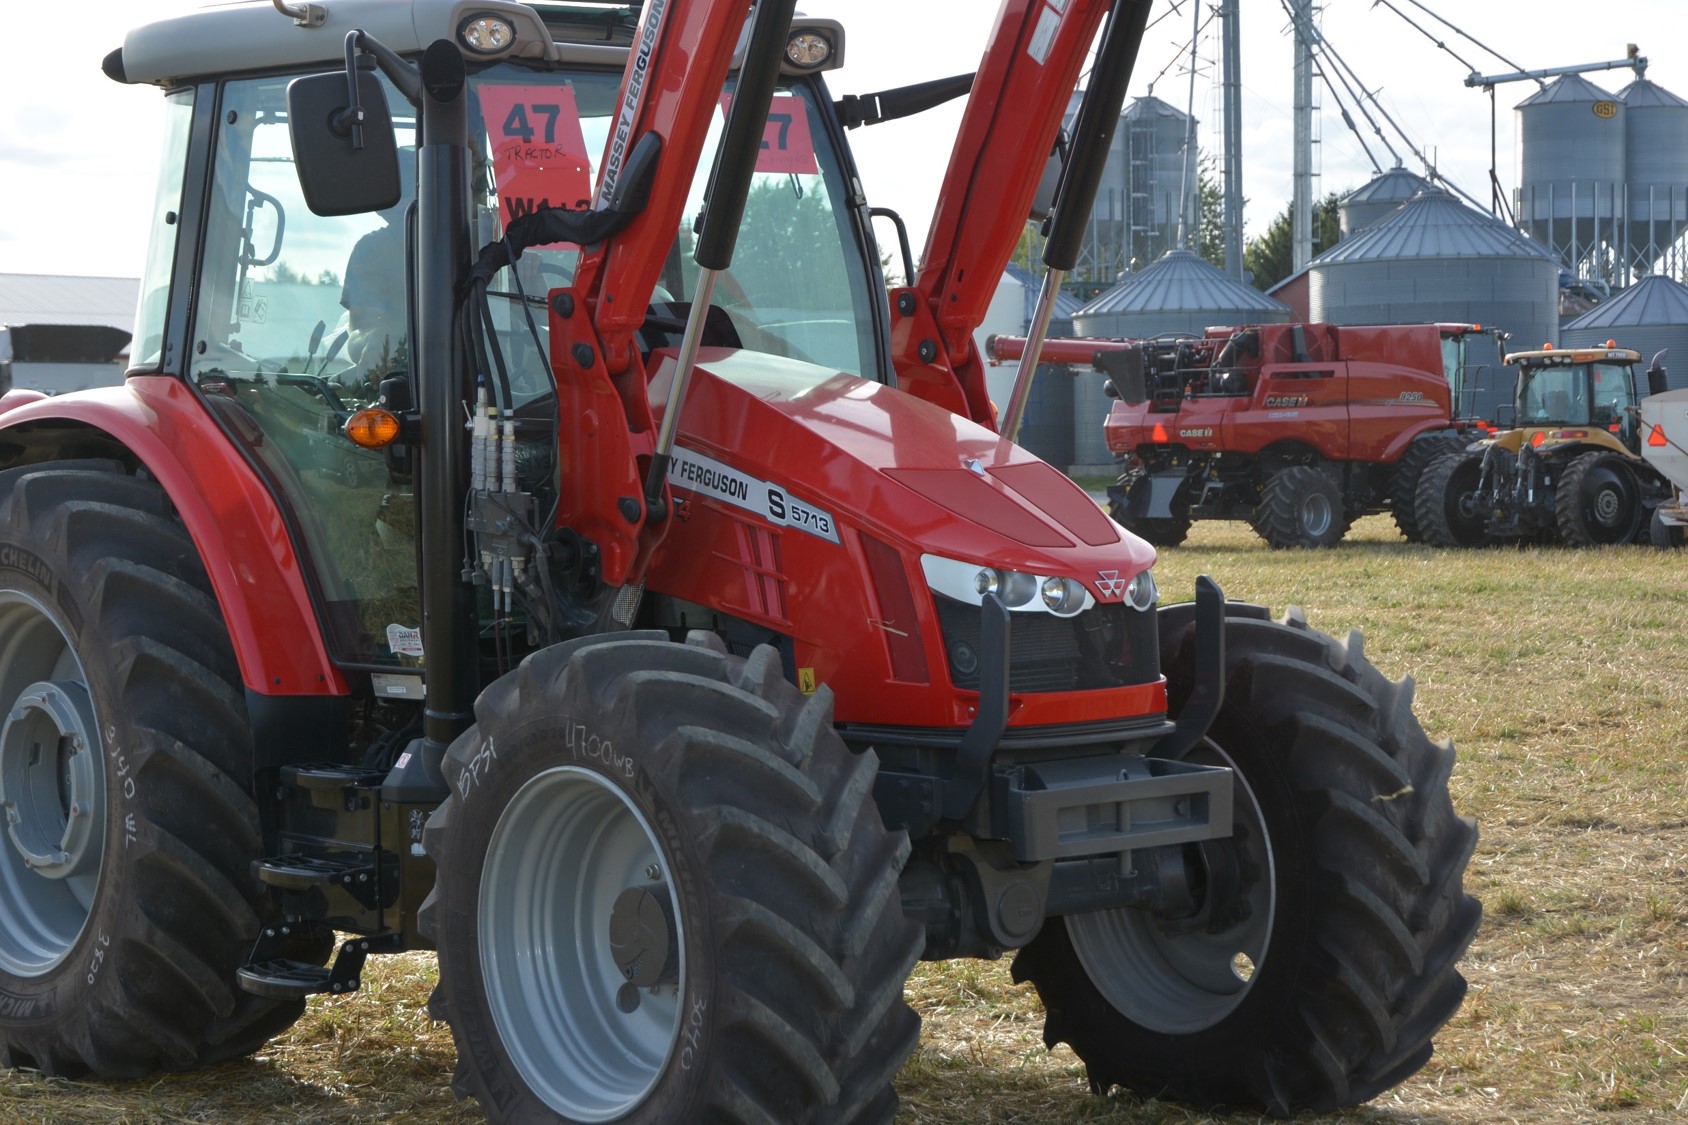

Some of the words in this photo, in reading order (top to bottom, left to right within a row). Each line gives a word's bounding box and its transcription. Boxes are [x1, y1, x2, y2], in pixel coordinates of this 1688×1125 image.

[601, 117, 630, 203] MASSEY
[625, 0, 665, 111] FERGUSON
[1596, 103, 1615, 116] GSI
[502, 103, 560, 143] 47
[760, 113, 792, 150] 7
[504, 144, 567, 161] TRACTOR
[1266, 397, 1297, 407] CASE
[1180, 429, 1204, 438] CASE
[680, 460, 748, 501] FERGUSON
[767, 488, 786, 520] S
[791, 505, 830, 534] 5713
[681, 991, 707, 1070] 3040
